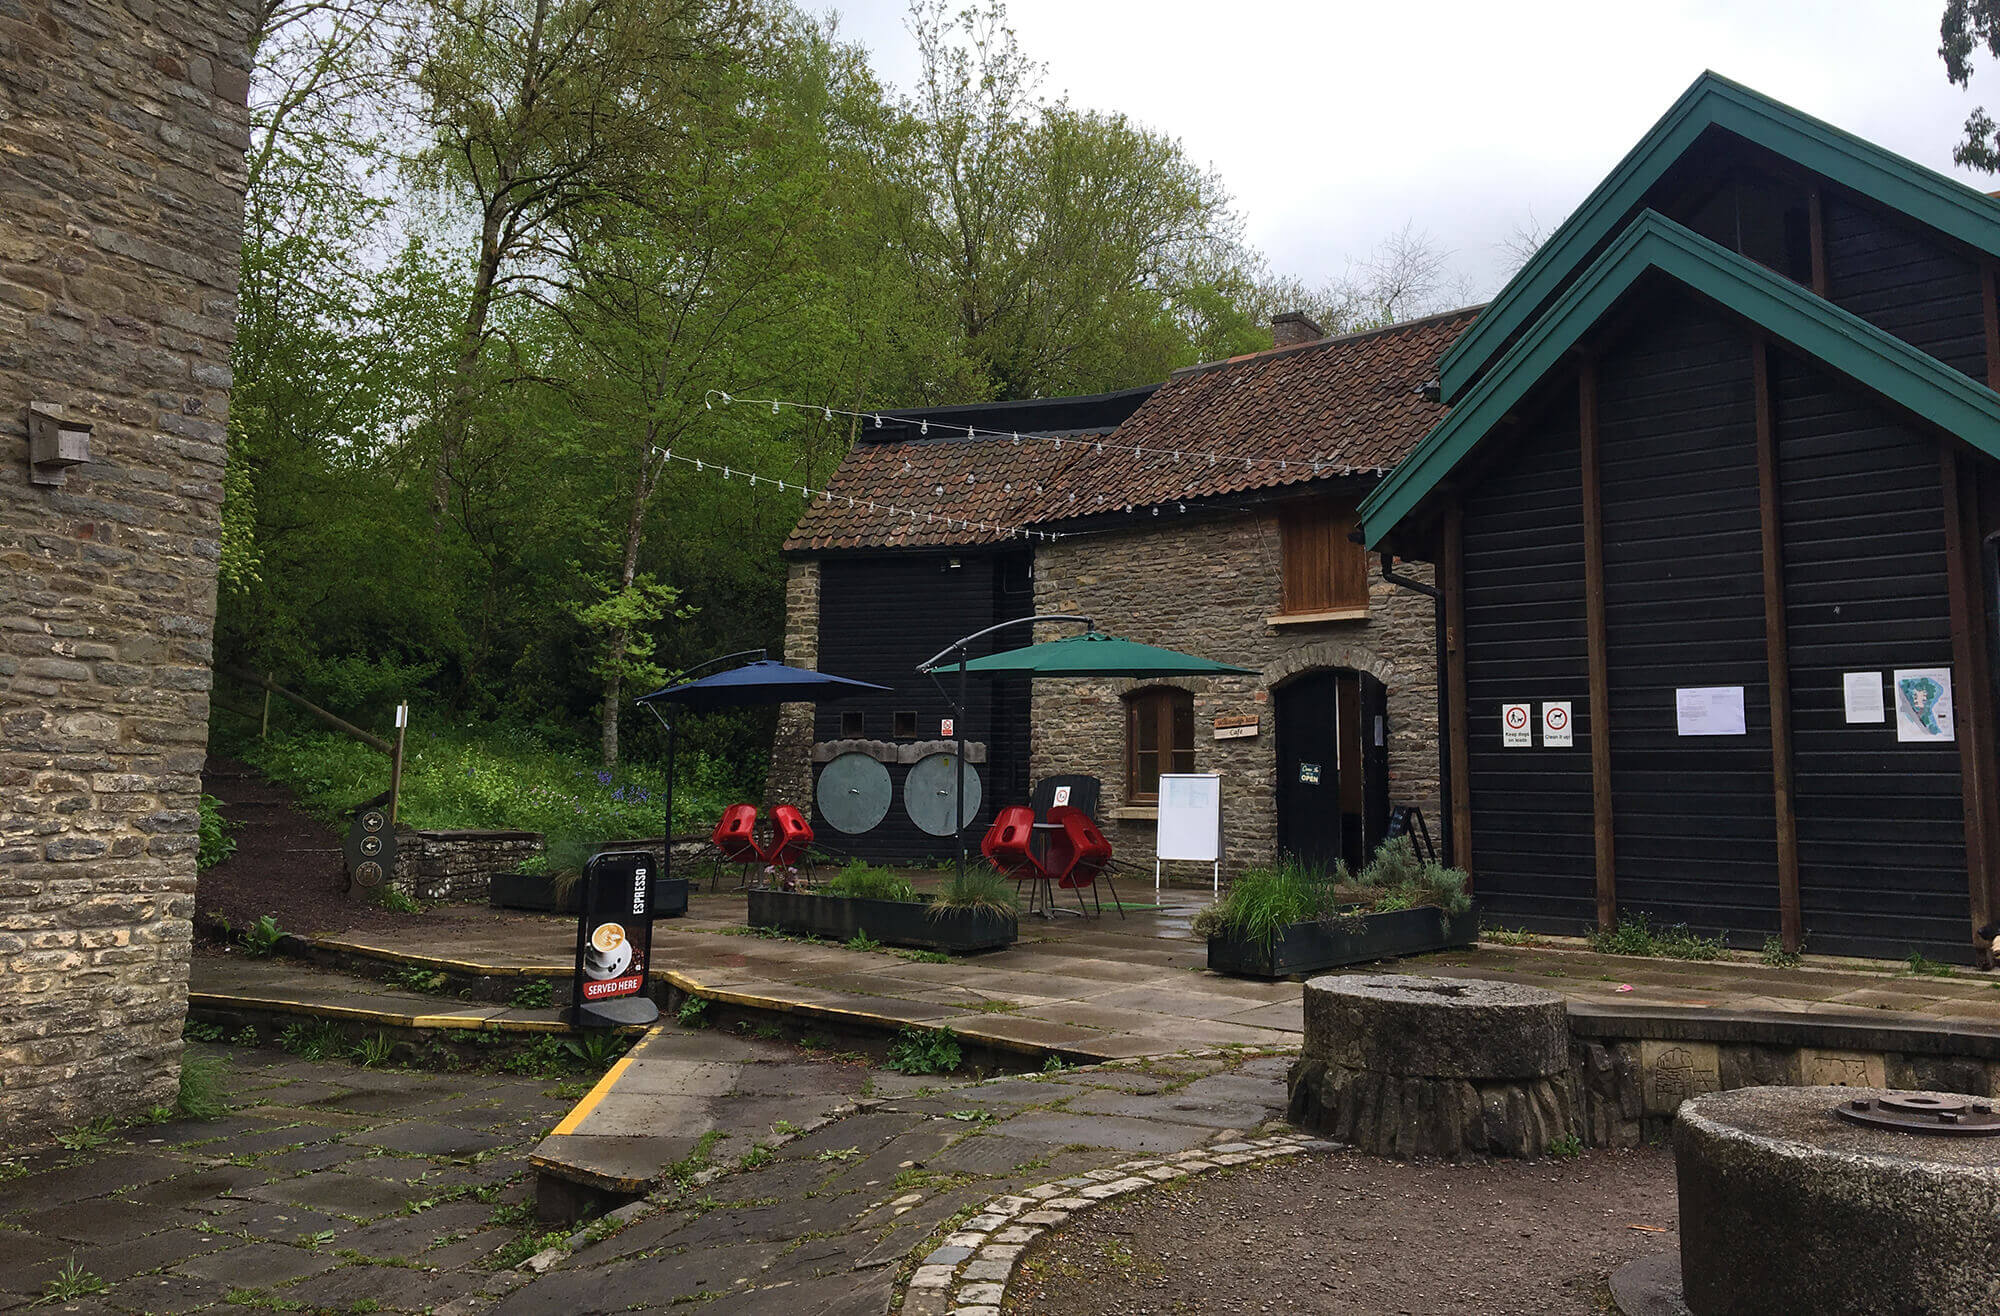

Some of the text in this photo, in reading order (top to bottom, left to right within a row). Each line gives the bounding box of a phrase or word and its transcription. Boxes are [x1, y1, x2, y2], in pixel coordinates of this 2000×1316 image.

[1301, 774, 1318, 782] OPEN
[633, 868, 646, 914] ESPRESSO
[588, 979, 638, 996] SERVED HERE
